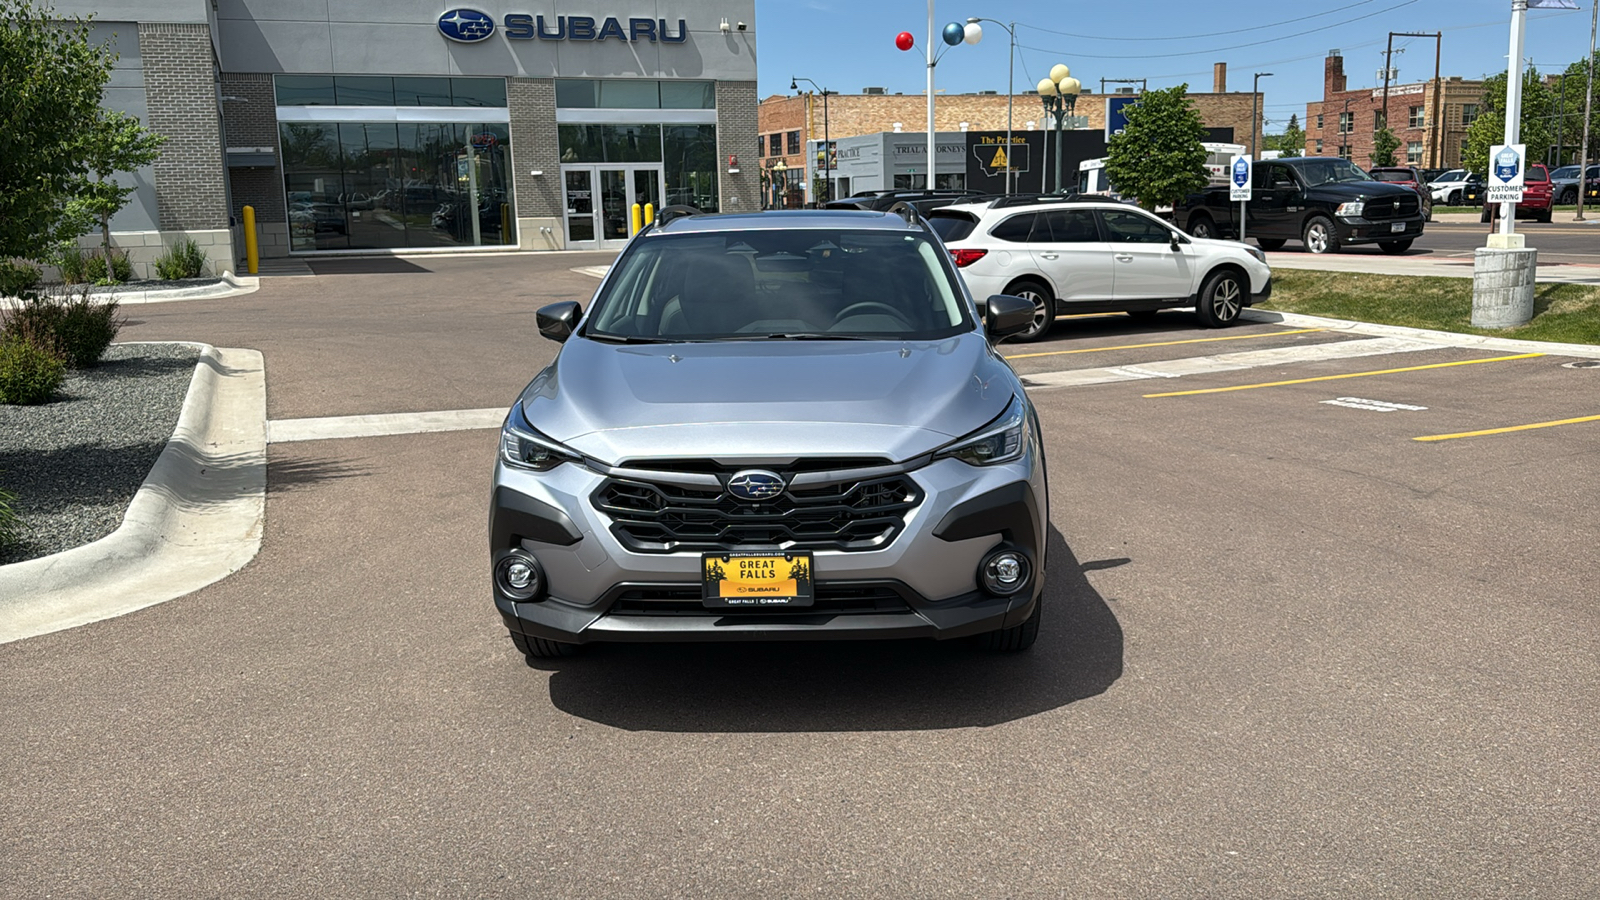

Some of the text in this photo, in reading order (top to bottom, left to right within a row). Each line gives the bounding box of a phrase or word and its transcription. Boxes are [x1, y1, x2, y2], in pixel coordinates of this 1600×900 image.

[504, 13, 687, 44] SUBARU
[981, 136, 995, 144] The
[838, 148, 860, 159] PRACTICE
[740, 560, 775, 569] GREAT
[740, 569, 776, 579] FALLS
